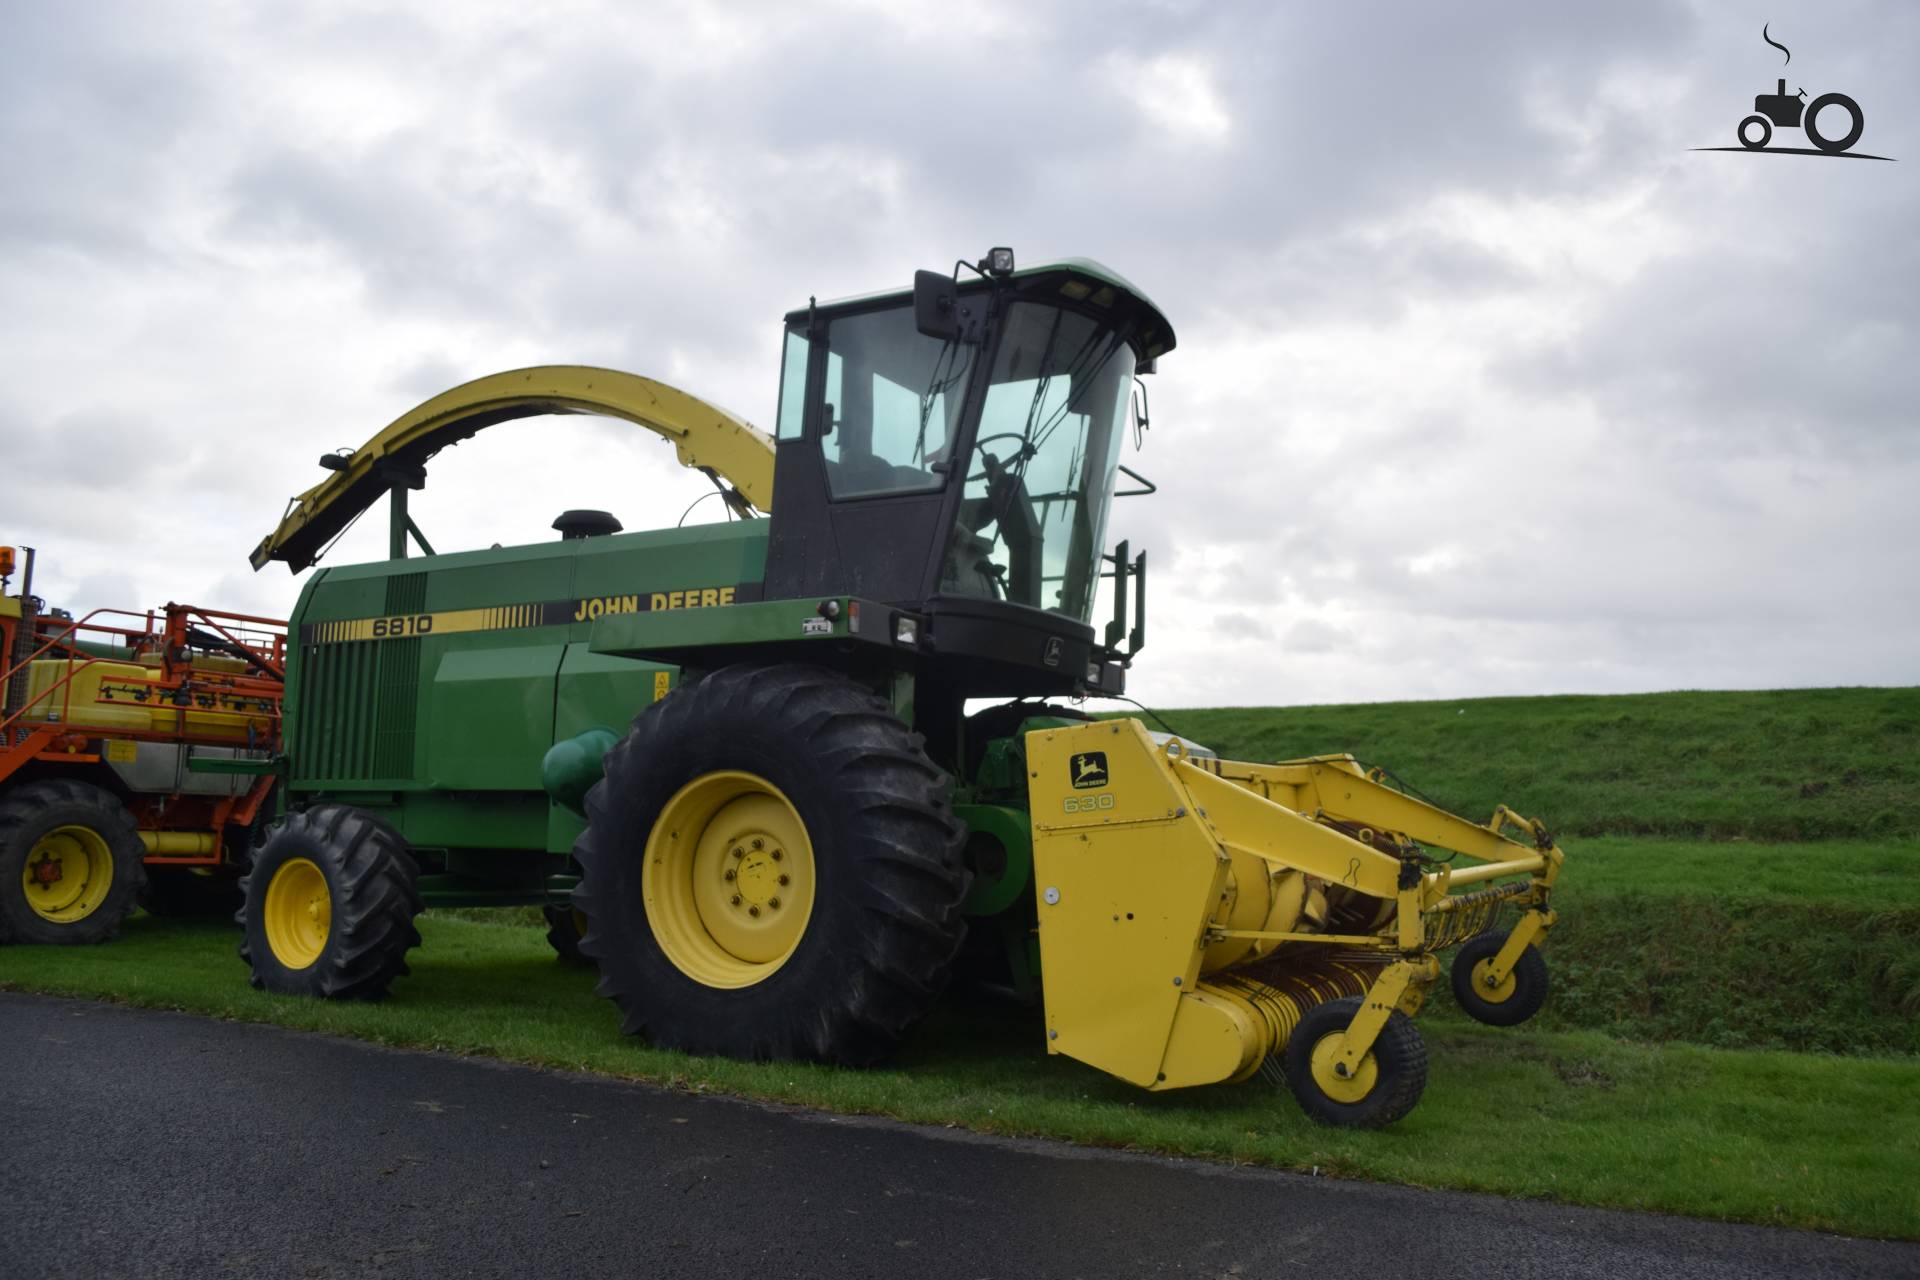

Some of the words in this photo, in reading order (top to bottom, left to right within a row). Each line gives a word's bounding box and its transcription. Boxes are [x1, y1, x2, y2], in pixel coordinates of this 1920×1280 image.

[574, 595, 638, 622] JOHN
[651, 586, 736, 612] DEERE
[373, 615, 433, 637] 6810
[1063, 793, 1114, 813] 630
